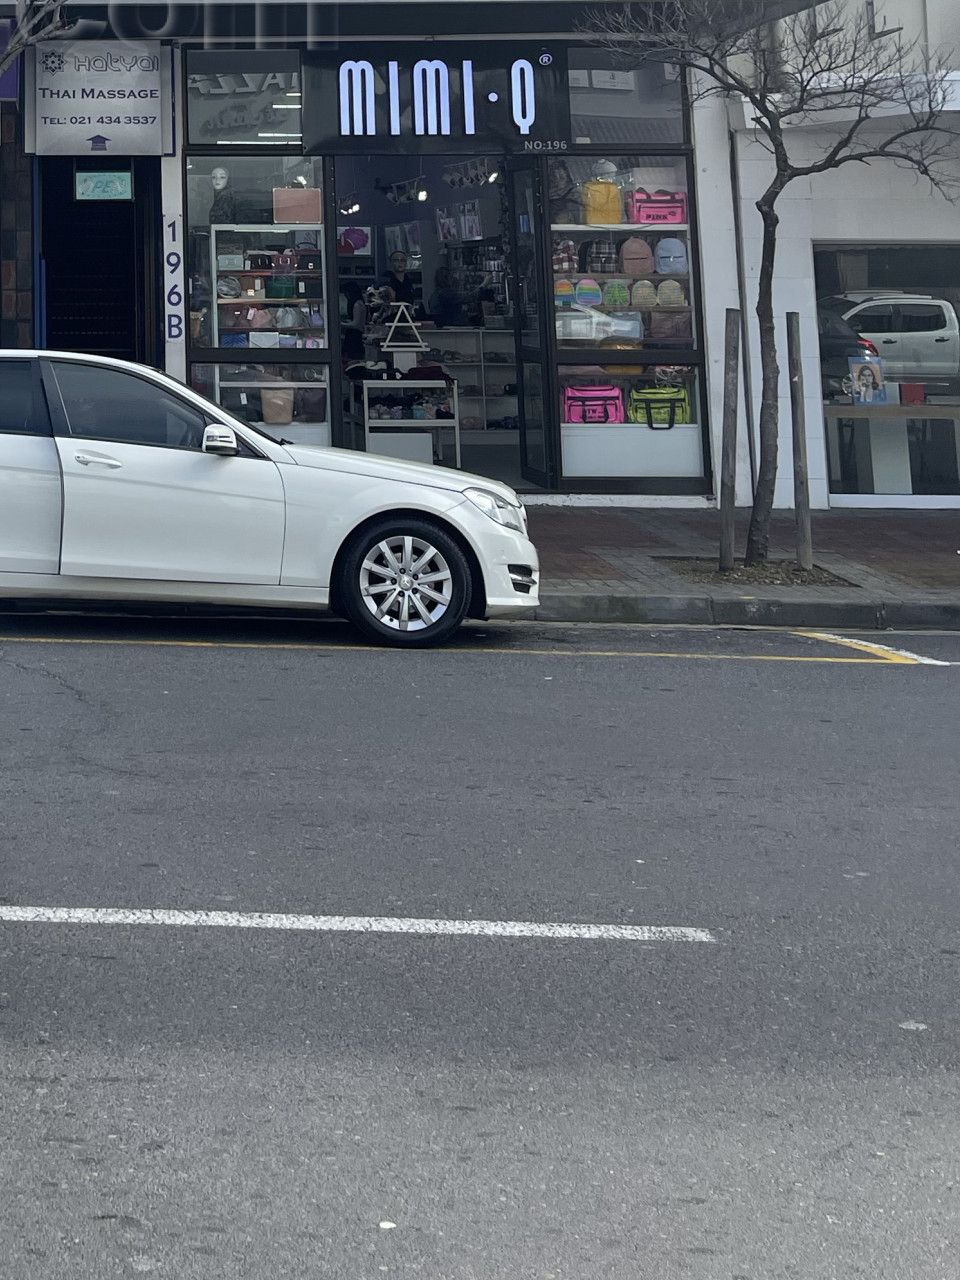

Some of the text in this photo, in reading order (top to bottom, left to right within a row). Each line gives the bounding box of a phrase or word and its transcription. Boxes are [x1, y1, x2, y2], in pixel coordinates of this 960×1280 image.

[38, 87, 159, 100] THAI MASSAGE
[70, 116, 91, 125] 021
[96, 116, 121, 125] 434
[124, 116, 157, 125] 3537
[524, 140, 567, 150] NO:196
